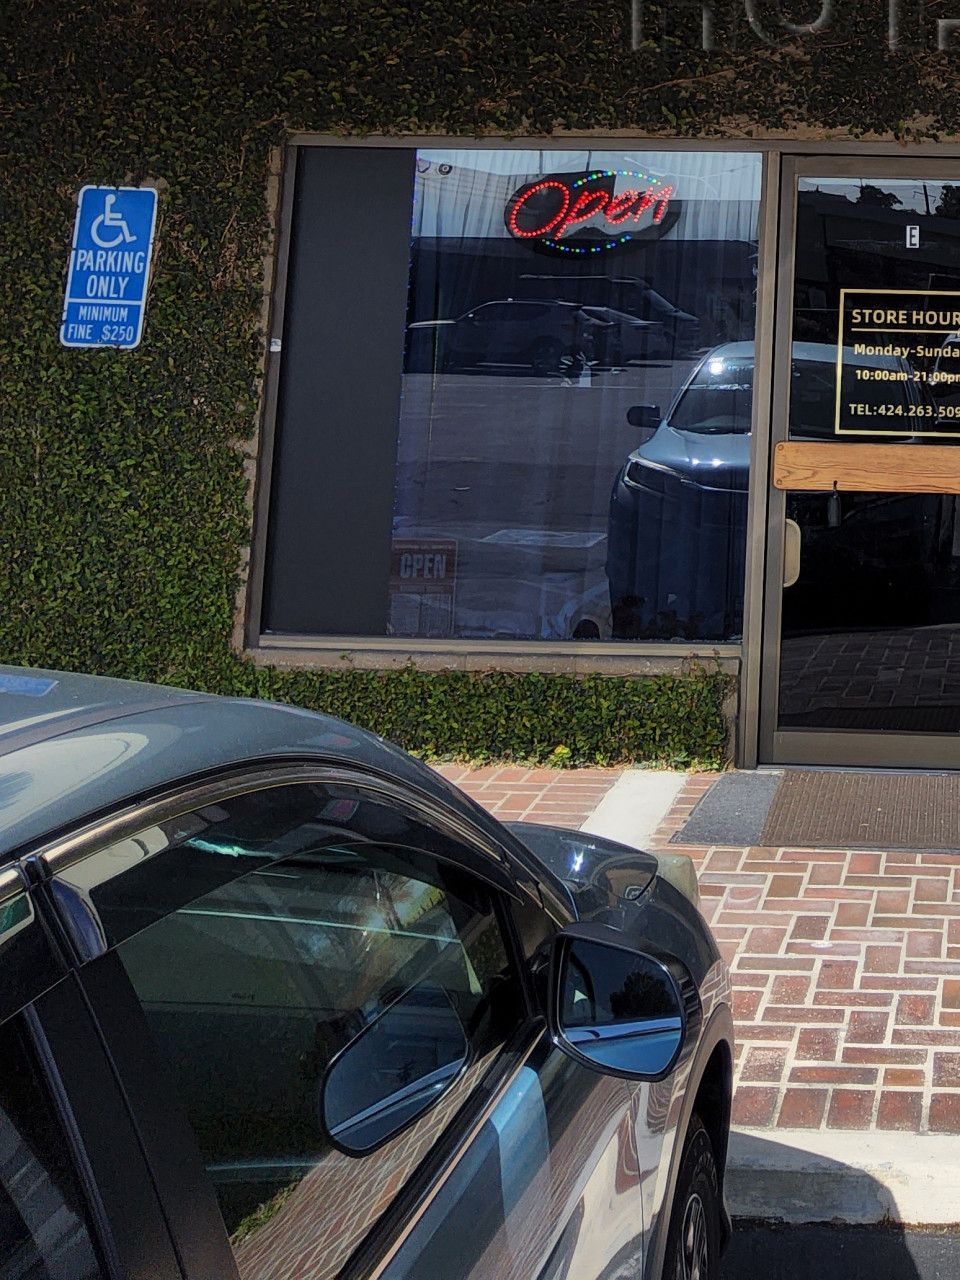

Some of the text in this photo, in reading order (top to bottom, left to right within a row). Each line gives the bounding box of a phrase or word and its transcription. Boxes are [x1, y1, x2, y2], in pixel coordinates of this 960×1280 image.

[510, 180, 673, 240] Open
[907, 227, 917, 247] E
[77, 250, 144, 273] PARKING
[86, 275, 129, 297] ONLY
[79, 306, 128, 322] MINIMUM
[852, 310, 907, 324] STORE
[68, 325, 134, 341] FINE $250
